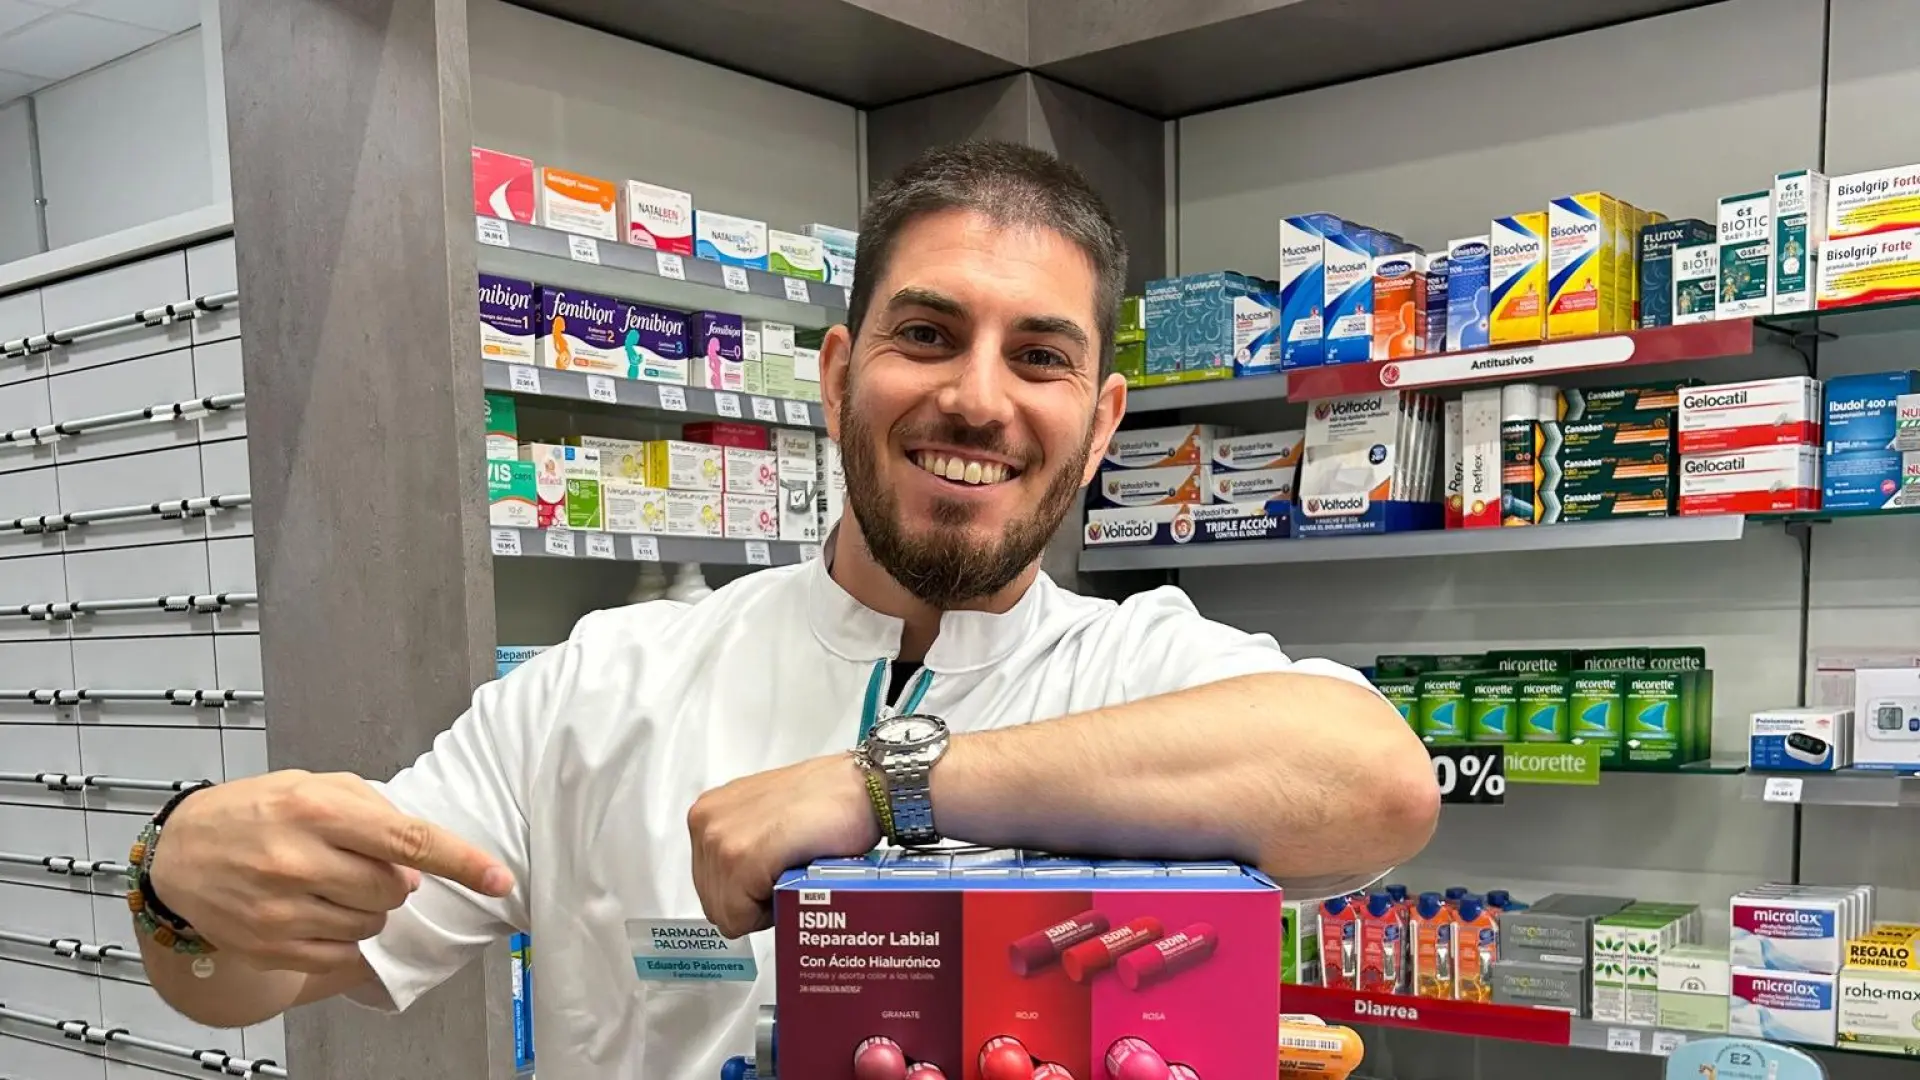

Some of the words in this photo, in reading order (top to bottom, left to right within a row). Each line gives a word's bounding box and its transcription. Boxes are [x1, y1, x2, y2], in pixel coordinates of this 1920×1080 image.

[1780, 190, 1804, 201] EFFER
[1838, 180, 1889, 196] Bisolgrip
[638, 202, 679, 220] NATALBEN
[1550, 222, 1597, 238] Bisolvon
[1721, 215, 1769, 233] BIOTIC
[1643, 229, 1684, 244] FLUTOX
[1282, 243, 1321, 257] Mucosan
[1492, 241, 1540, 257] Bisolvon
[1826, 244, 1877, 261] Bisolgrip
[1881, 240, 1913, 254] Forte
[1326, 261, 1367, 274] Mucosan
[545, 292, 615, 326] femibion
[1236, 311, 1274, 322] Mucosan
[521, 315, 530, 330] 1
[619, 305, 683, 337] femibion
[606, 329, 616, 344] 2
[704, 321, 742, 337] femibion
[674, 340, 684, 355] 3
[1471, 355, 1535, 371] Antitusivos
[1587, 389, 1626, 401] Cannaben
[1683, 391, 1748, 410] Gelocatil
[1330, 398, 1382, 416] Voltadol
[1829, 400, 1865, 412] Ibudol
[1866, 399, 1886, 409] 400
[1564, 423, 1604, 435] Cannaben
[1119, 441, 1143, 451] Voltadol
[1143, 440, 1160, 448] Forte
[1563, 458, 1603, 469] Cannaben
[1684, 456, 1746, 475] Gelocatil
[1473, 453, 1484, 494] Reflex
[1120, 482, 1143, 490] Voltadol
[1143, 480, 1160, 488] Forte
[1257, 478, 1274, 486] Forte
[1318, 497, 1363, 511] Voltadol
[1563, 492, 1602, 503] Cannaben
[1192, 508, 1221, 517] Voltadol
[1221, 507, 1240, 515] Forte
[1103, 519, 1153, 540] Voltadol
[1205, 520, 1236, 533] TRIPLE
[1236, 516, 1277, 530] ACCIÓN
[1215, 530, 1239, 539] CONTRA
[1246, 528, 1267, 537] DOLOR
[1499, 658, 1558, 672] nicorette
[1585, 656, 1646, 671] nicorette
[1424, 680, 1462, 691] nicorette
[1474, 684, 1514, 695] nicorette
[1523, 684, 1564, 695] nicorette
[1575, 679, 1616, 690] nicorette
[1631, 679, 1675, 691] nicorette
[1503, 752, 1586, 772] nicorette
[804, 892, 826, 902] NUEVO
[799, 912, 847, 930] ISDIN
[1753, 909, 1820, 926] micralax
[650, 928, 720, 938] FARMACIA
[1045, 919, 1078, 939] ISDIN
[1100, 926, 1133, 946] ISDIN
[654, 940, 729, 950] PALOMERA
[799, 931, 886, 949] Reparador
[889, 931, 941, 947] Labial
[1155, 931, 1188, 951] ISDIN
[1850, 944, 1910, 960] REGALO
[646, 960, 692, 971] Eduardo
[693, 961, 745, 972] Palomera
[799, 955, 826, 968] Con
[828, 952, 866, 968] Ácido
[868, 953, 941, 969] Hialurónico
[1850, 957, 1908, 968] MONEDERO
[831, 973, 836, 982] y
[838, 972, 866, 982] aporta
[866, 972, 888, 980] color
[896, 972, 909, 980] los
[1752, 979, 1818, 996] micralax
[881, 1010, 920, 1019] GRANATE
[1015, 1011, 1039, 1020] ROJO
[1142, 1012, 1166, 1021] ROSA
[1354, 1000, 1418, 1020] Diarrea
[1730, 1053, 1752, 1066] E2
